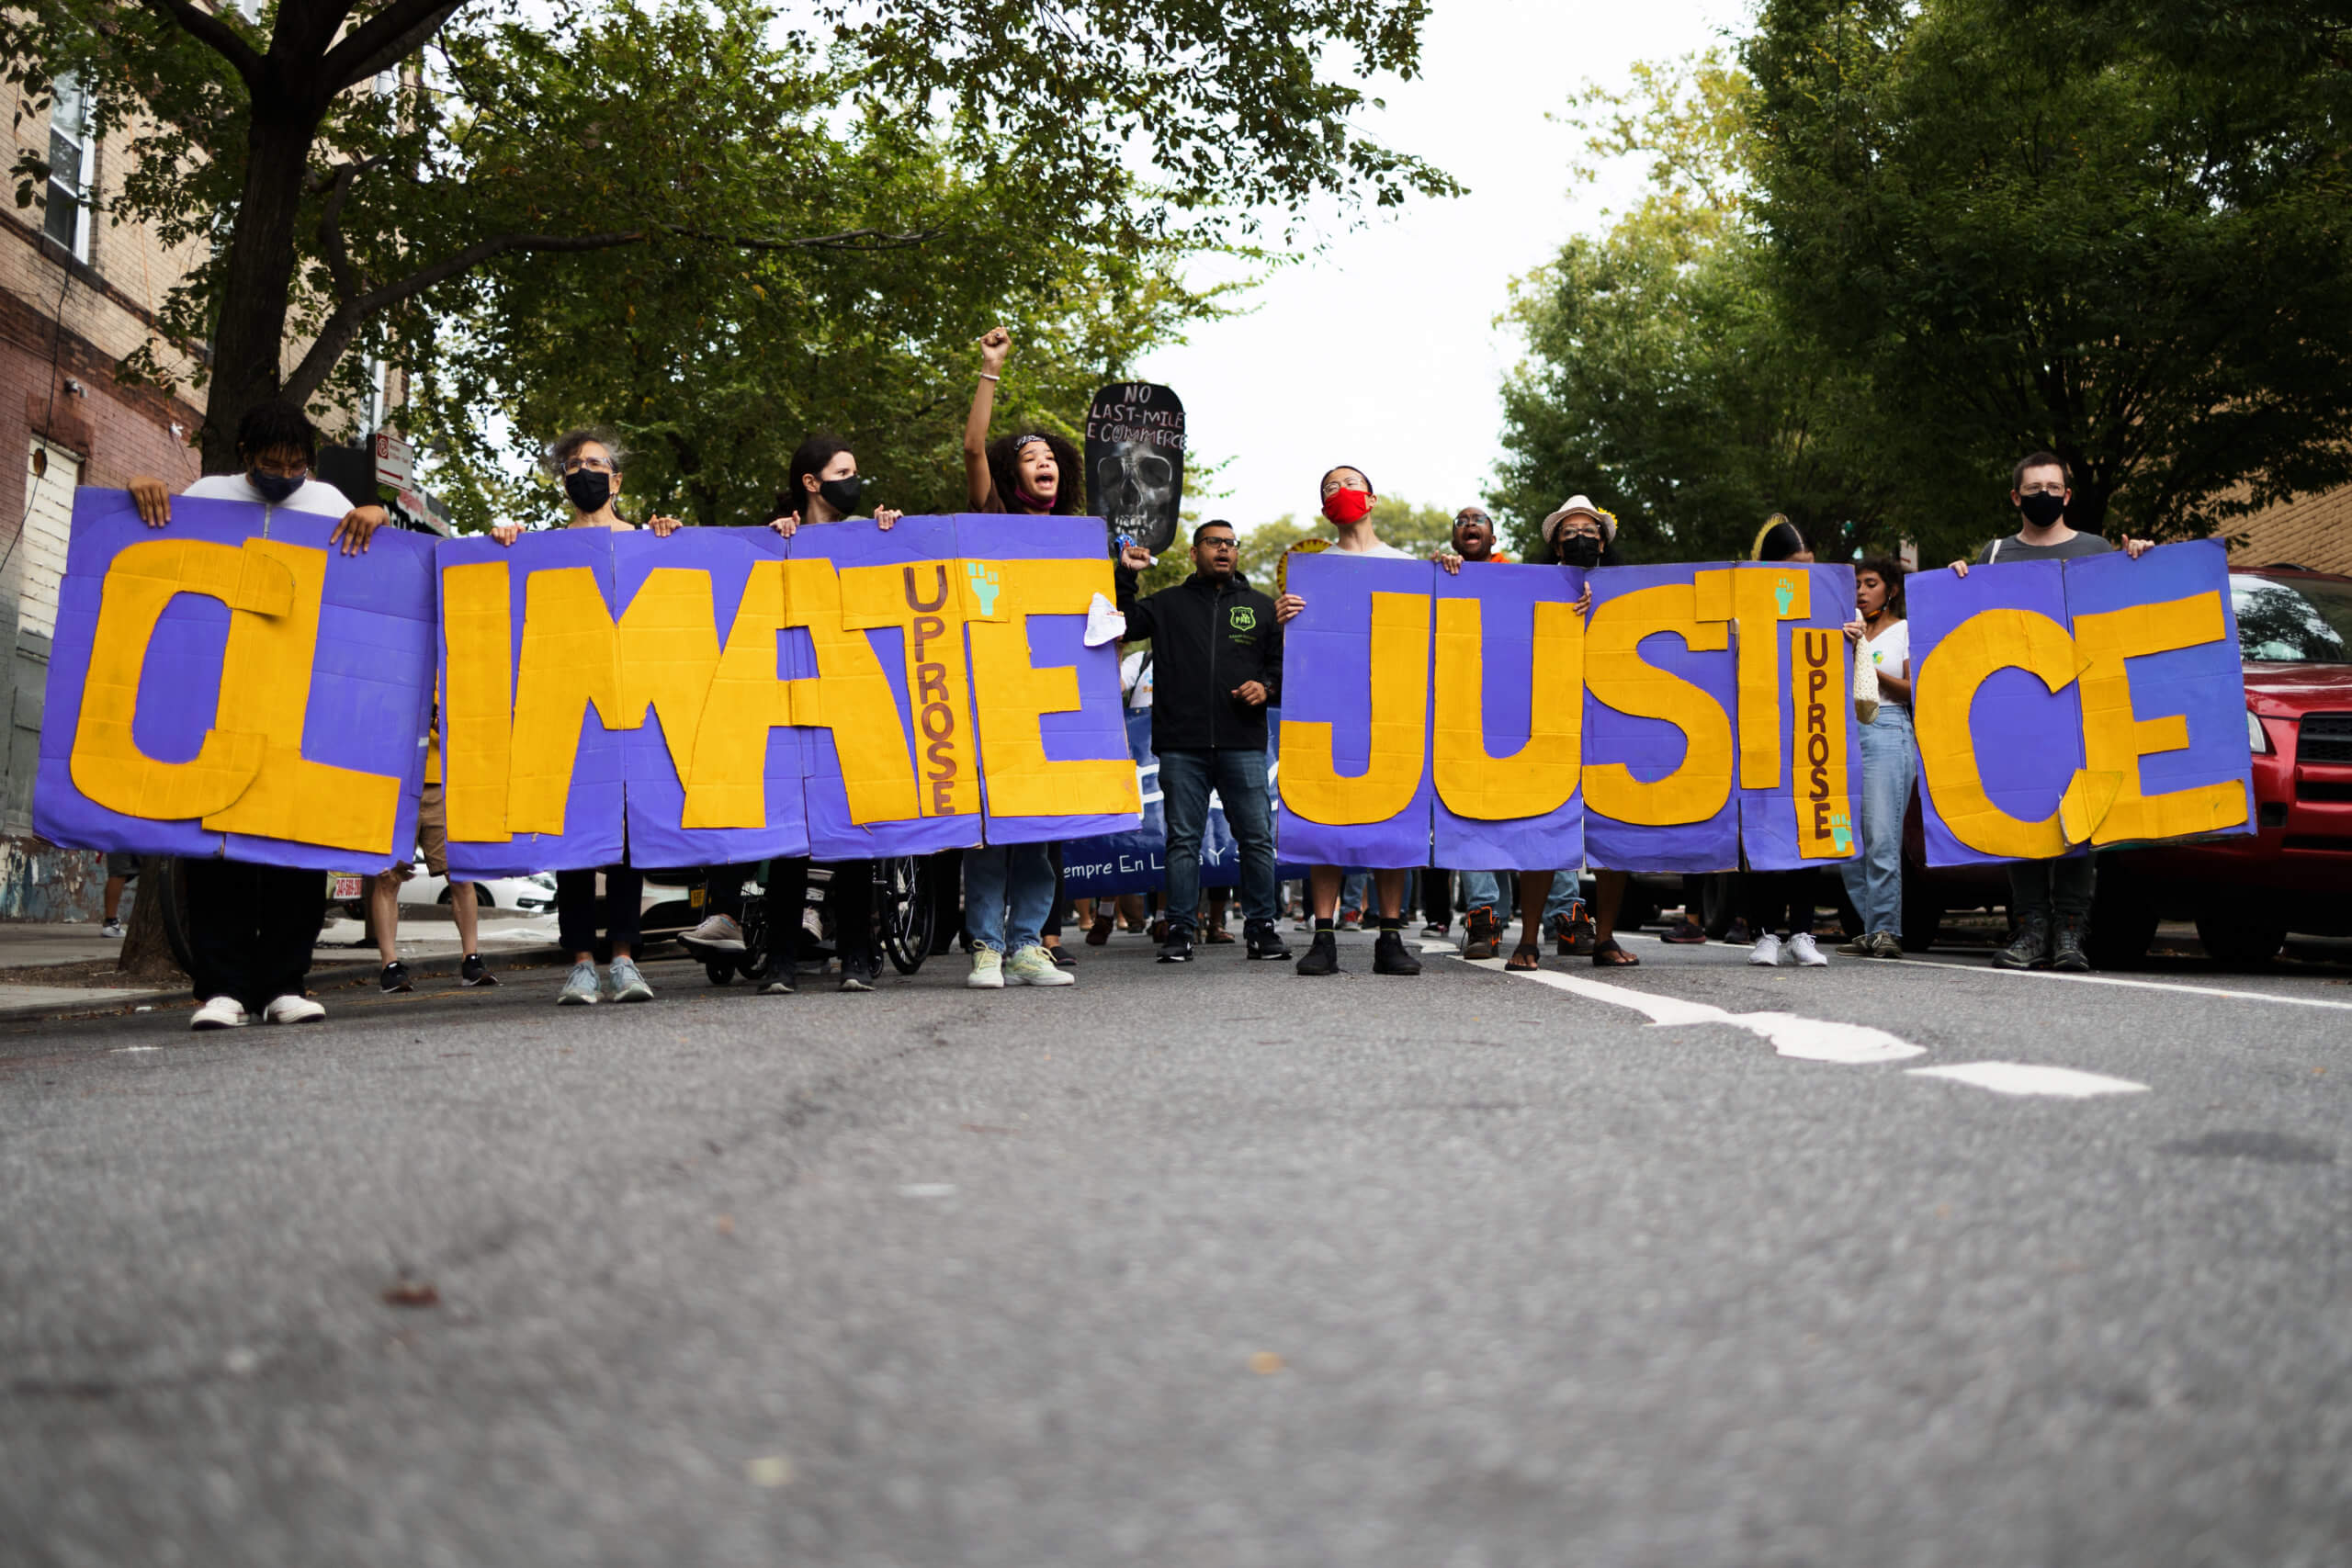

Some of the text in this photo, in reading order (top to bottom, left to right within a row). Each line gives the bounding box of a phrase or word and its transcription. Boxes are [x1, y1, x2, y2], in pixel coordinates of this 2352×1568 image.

[1124, 385, 1152, 404] NO
[1091, 403, 1186, 429] LAST-MILE
[1087, 423, 1187, 450] E COMMERCE
[70, 536, 2248, 860] CLIMATE JUSTICE
[903, 564, 956, 816] UPROSE
[1804, 631, 1832, 840] UPROSE
[1063, 863, 1113, 879] empre
[1119, 854, 1144, 873] En
